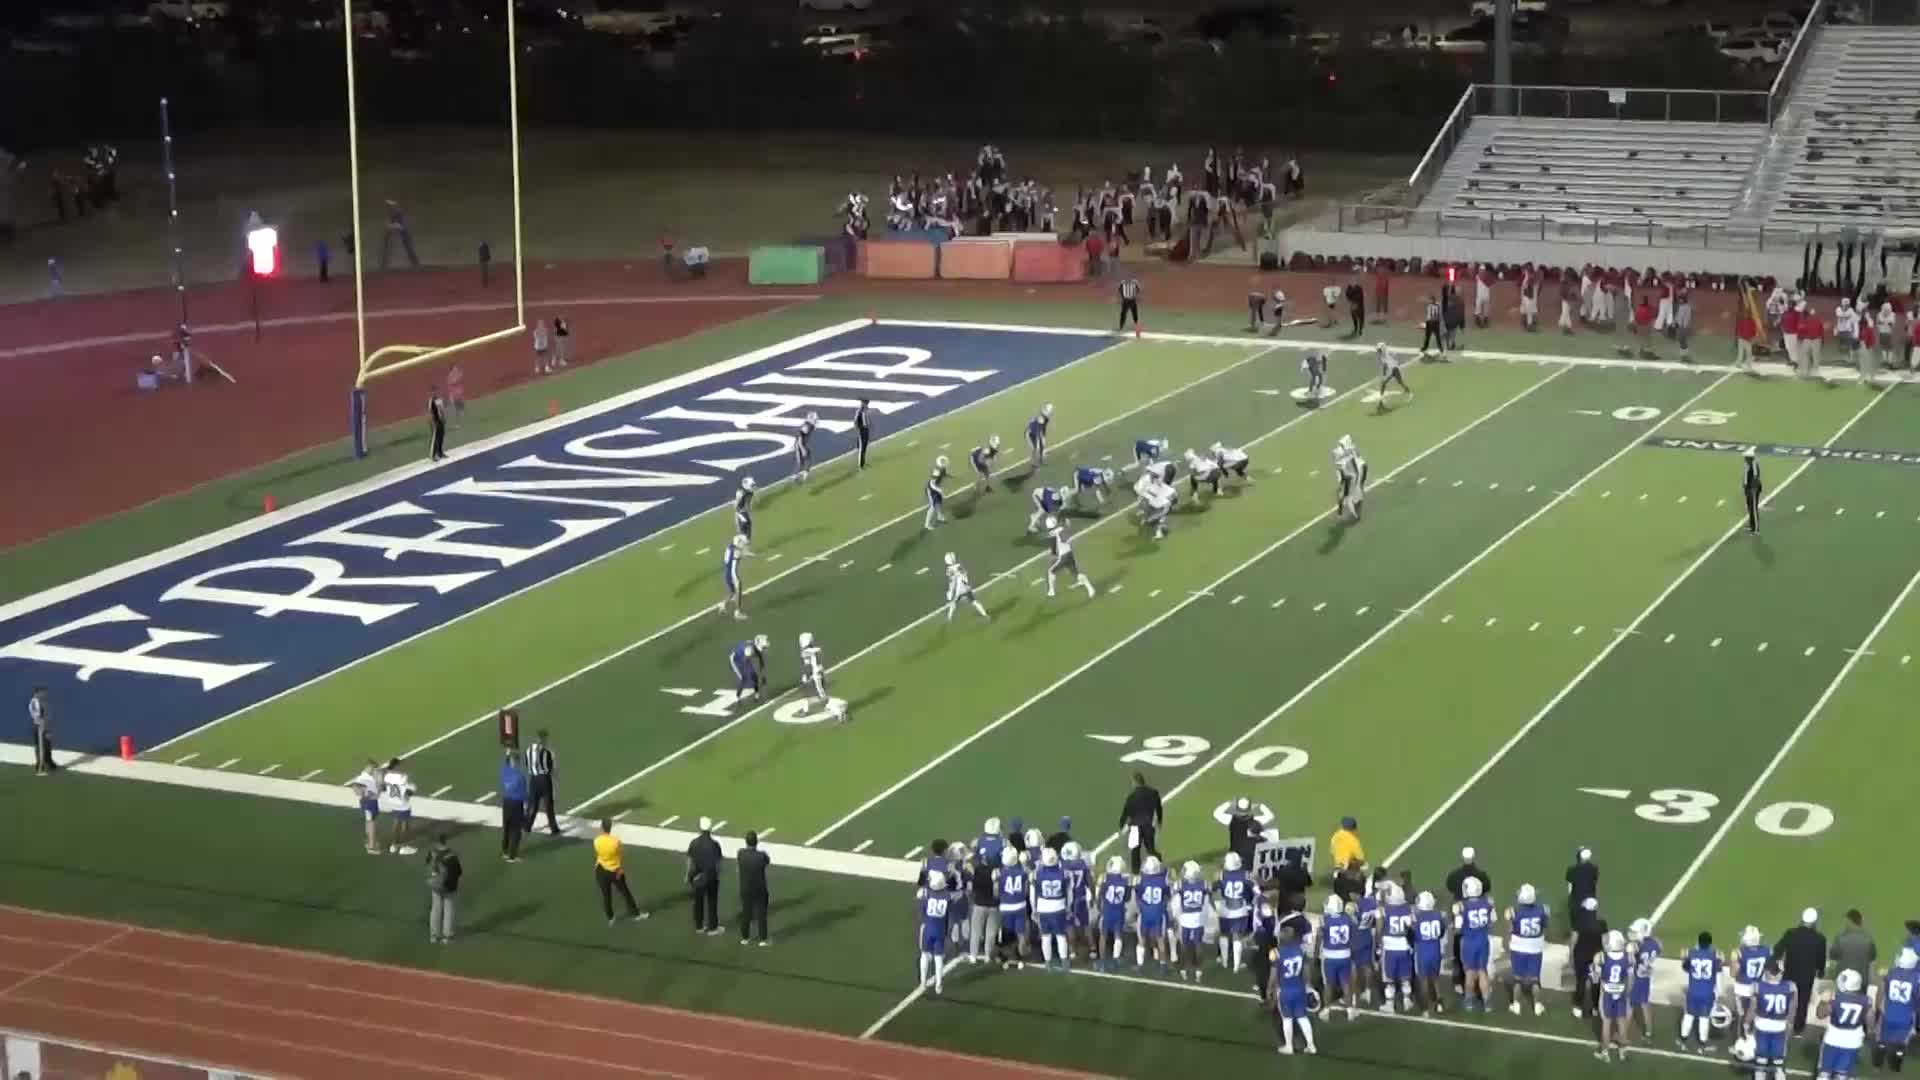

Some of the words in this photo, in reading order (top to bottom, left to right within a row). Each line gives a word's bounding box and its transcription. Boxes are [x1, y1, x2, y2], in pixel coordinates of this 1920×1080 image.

[2, 345, 998, 691] FRENSHIP
[1120, 734, 1309, 778] 20
[1632, 788, 1836, 837] 30
[1259, 844, 1312, 864] TUN
[1004, 875, 1023, 895] 44
[1042, 880, 1062, 897] 62
[1224, 880, 1244, 899] 42
[1468, 908, 1488, 929] 56
[1520, 917, 1541, 937] 65
[1329, 926, 1350, 945] 53
[1419, 920, 1441, 941] 90
[1283, 956, 1304, 979] 37
[1609, 964, 1621, 983] 8
[1690, 958, 1713, 980] 33
[1745, 958, 1766, 979] 67
[1889, 979, 1913, 1004] 63
[1763, 994, 1787, 1013] 70
[1840, 1002, 1863, 1025] 77
